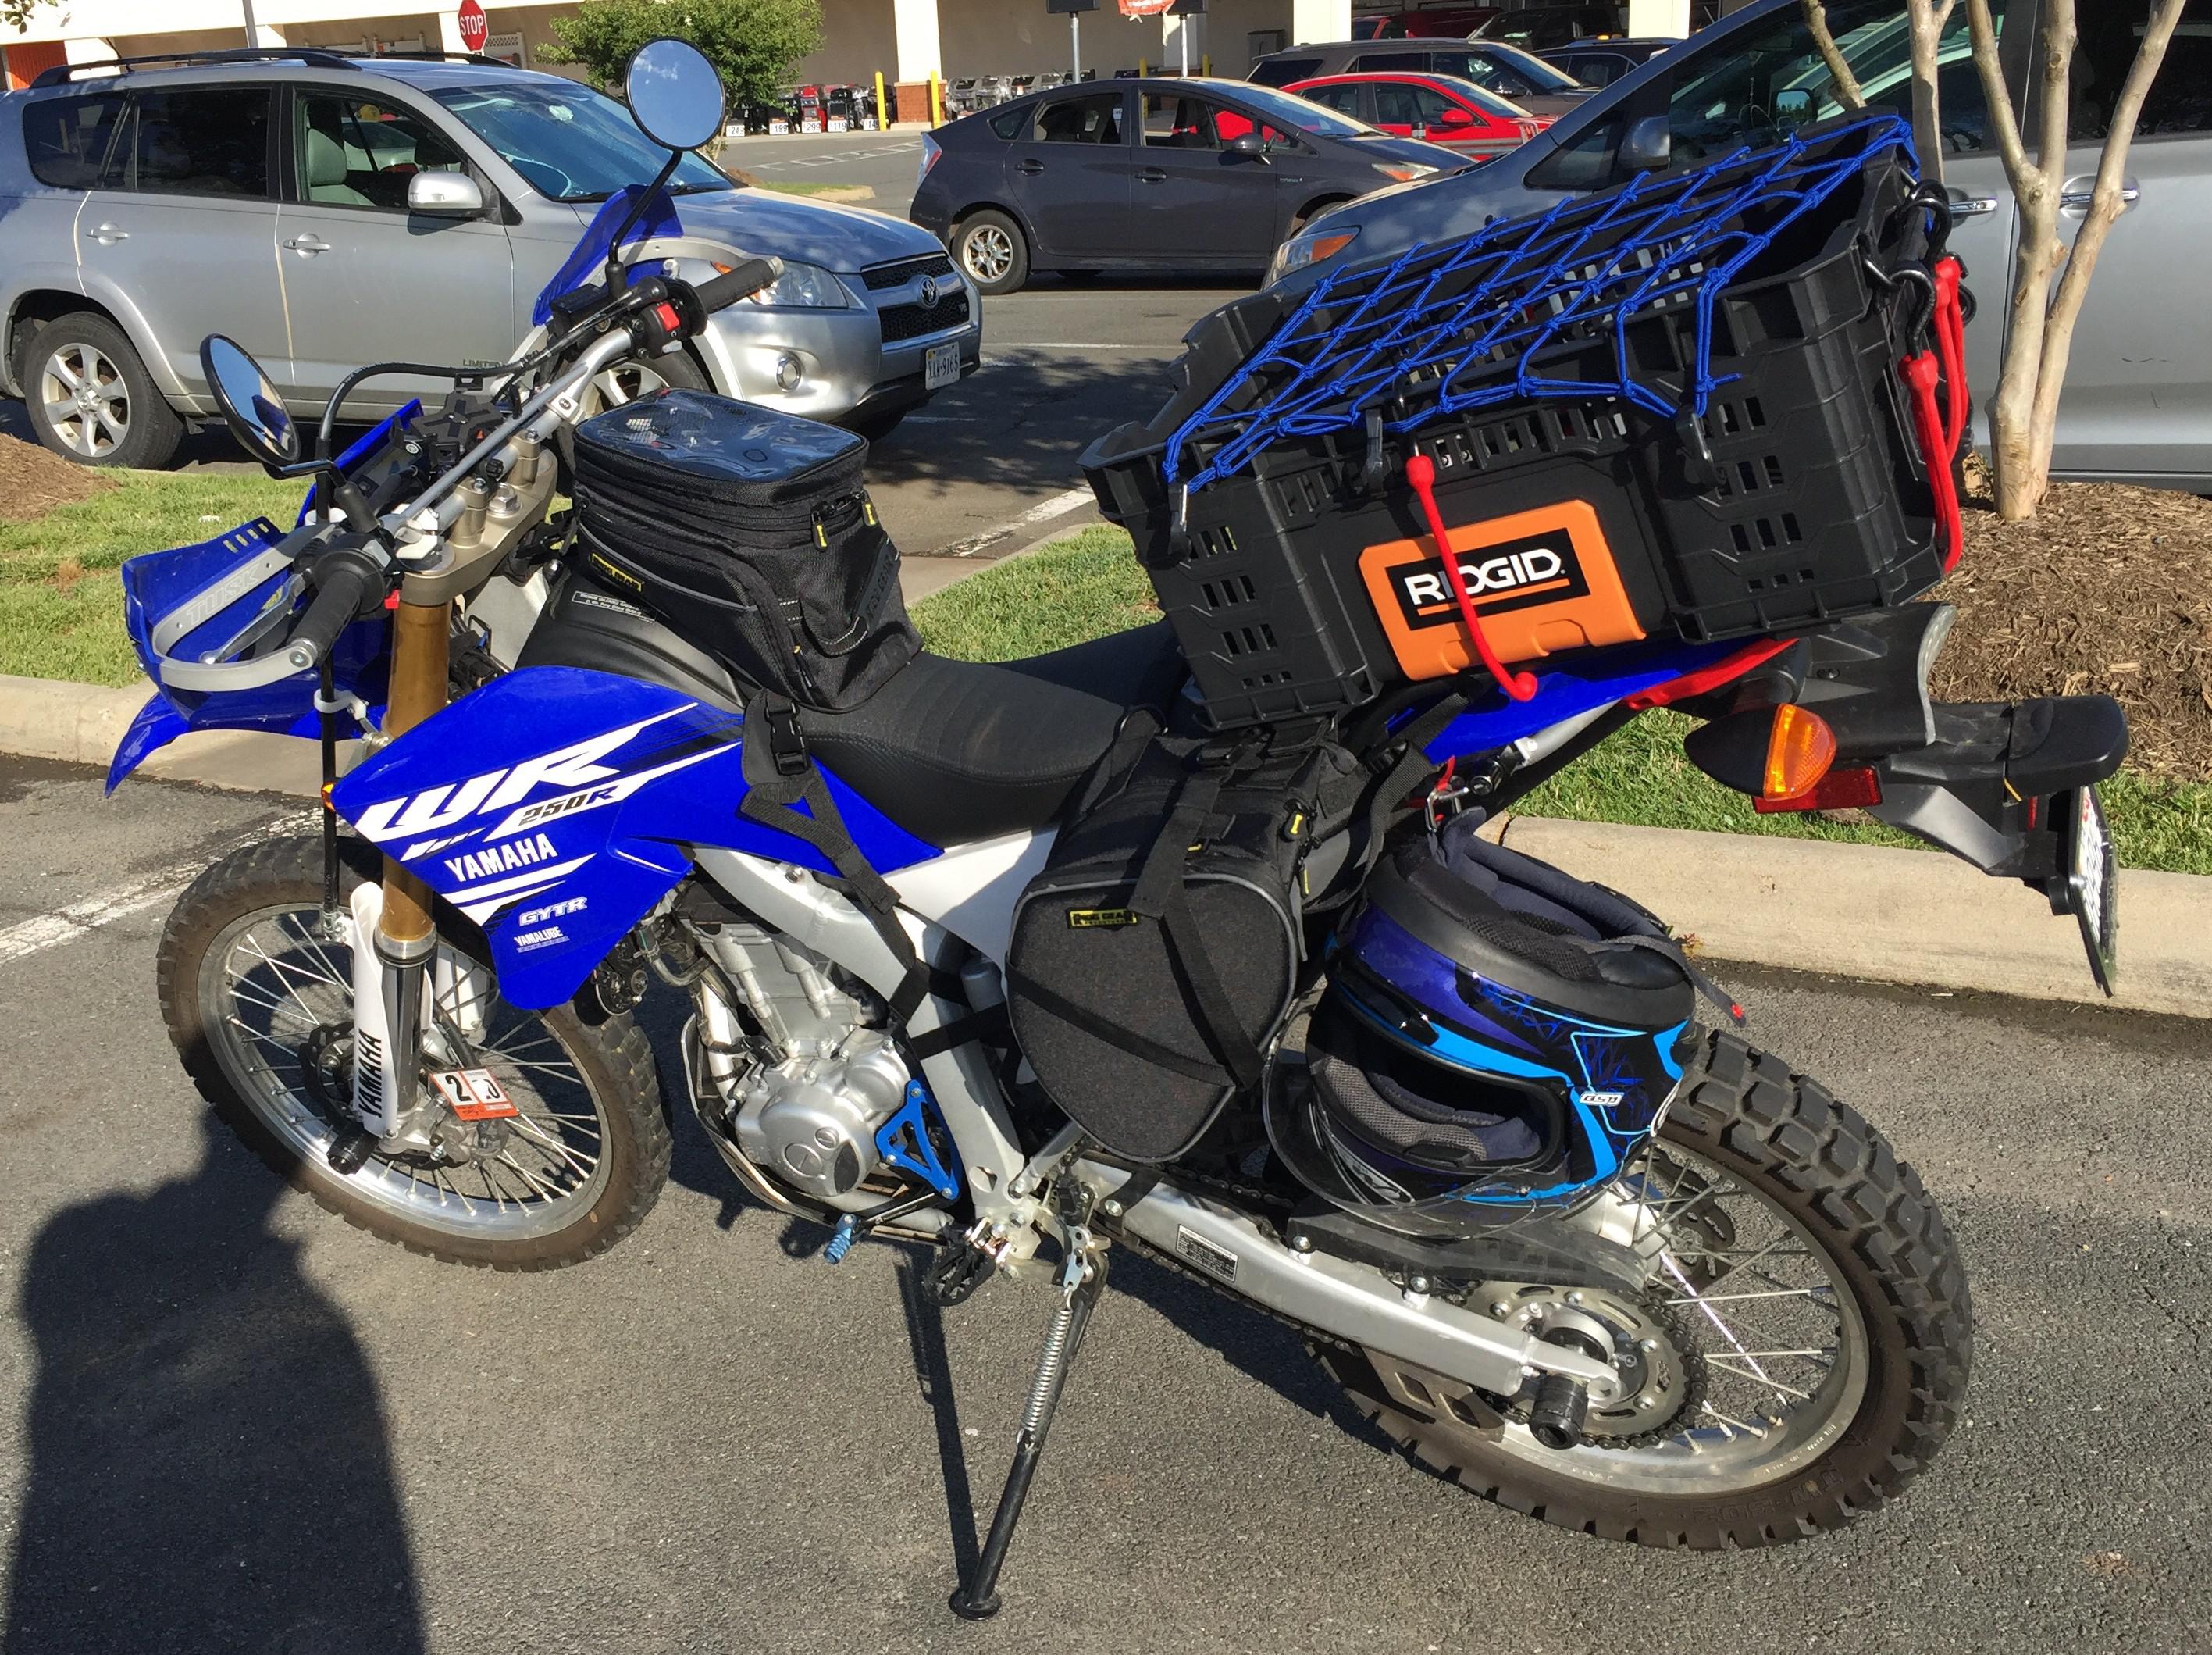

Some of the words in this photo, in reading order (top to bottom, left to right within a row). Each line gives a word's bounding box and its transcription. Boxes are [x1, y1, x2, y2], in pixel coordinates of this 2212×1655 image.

[460, 14, 484, 36] STOP
[187, 562, 260, 626] TUSK
[1404, 548, 1562, 606] RIDGID
[355, 719, 652, 843] WR
[518, 784, 614, 827] 250R
[444, 833, 558, 883] YAMAHA
[519, 896, 587, 926] GYTR
[514, 926, 564, 947] YAMALUBE
[358, 1028, 383, 1119] YAMAHA
[444, 1075, 472, 1101] 2
